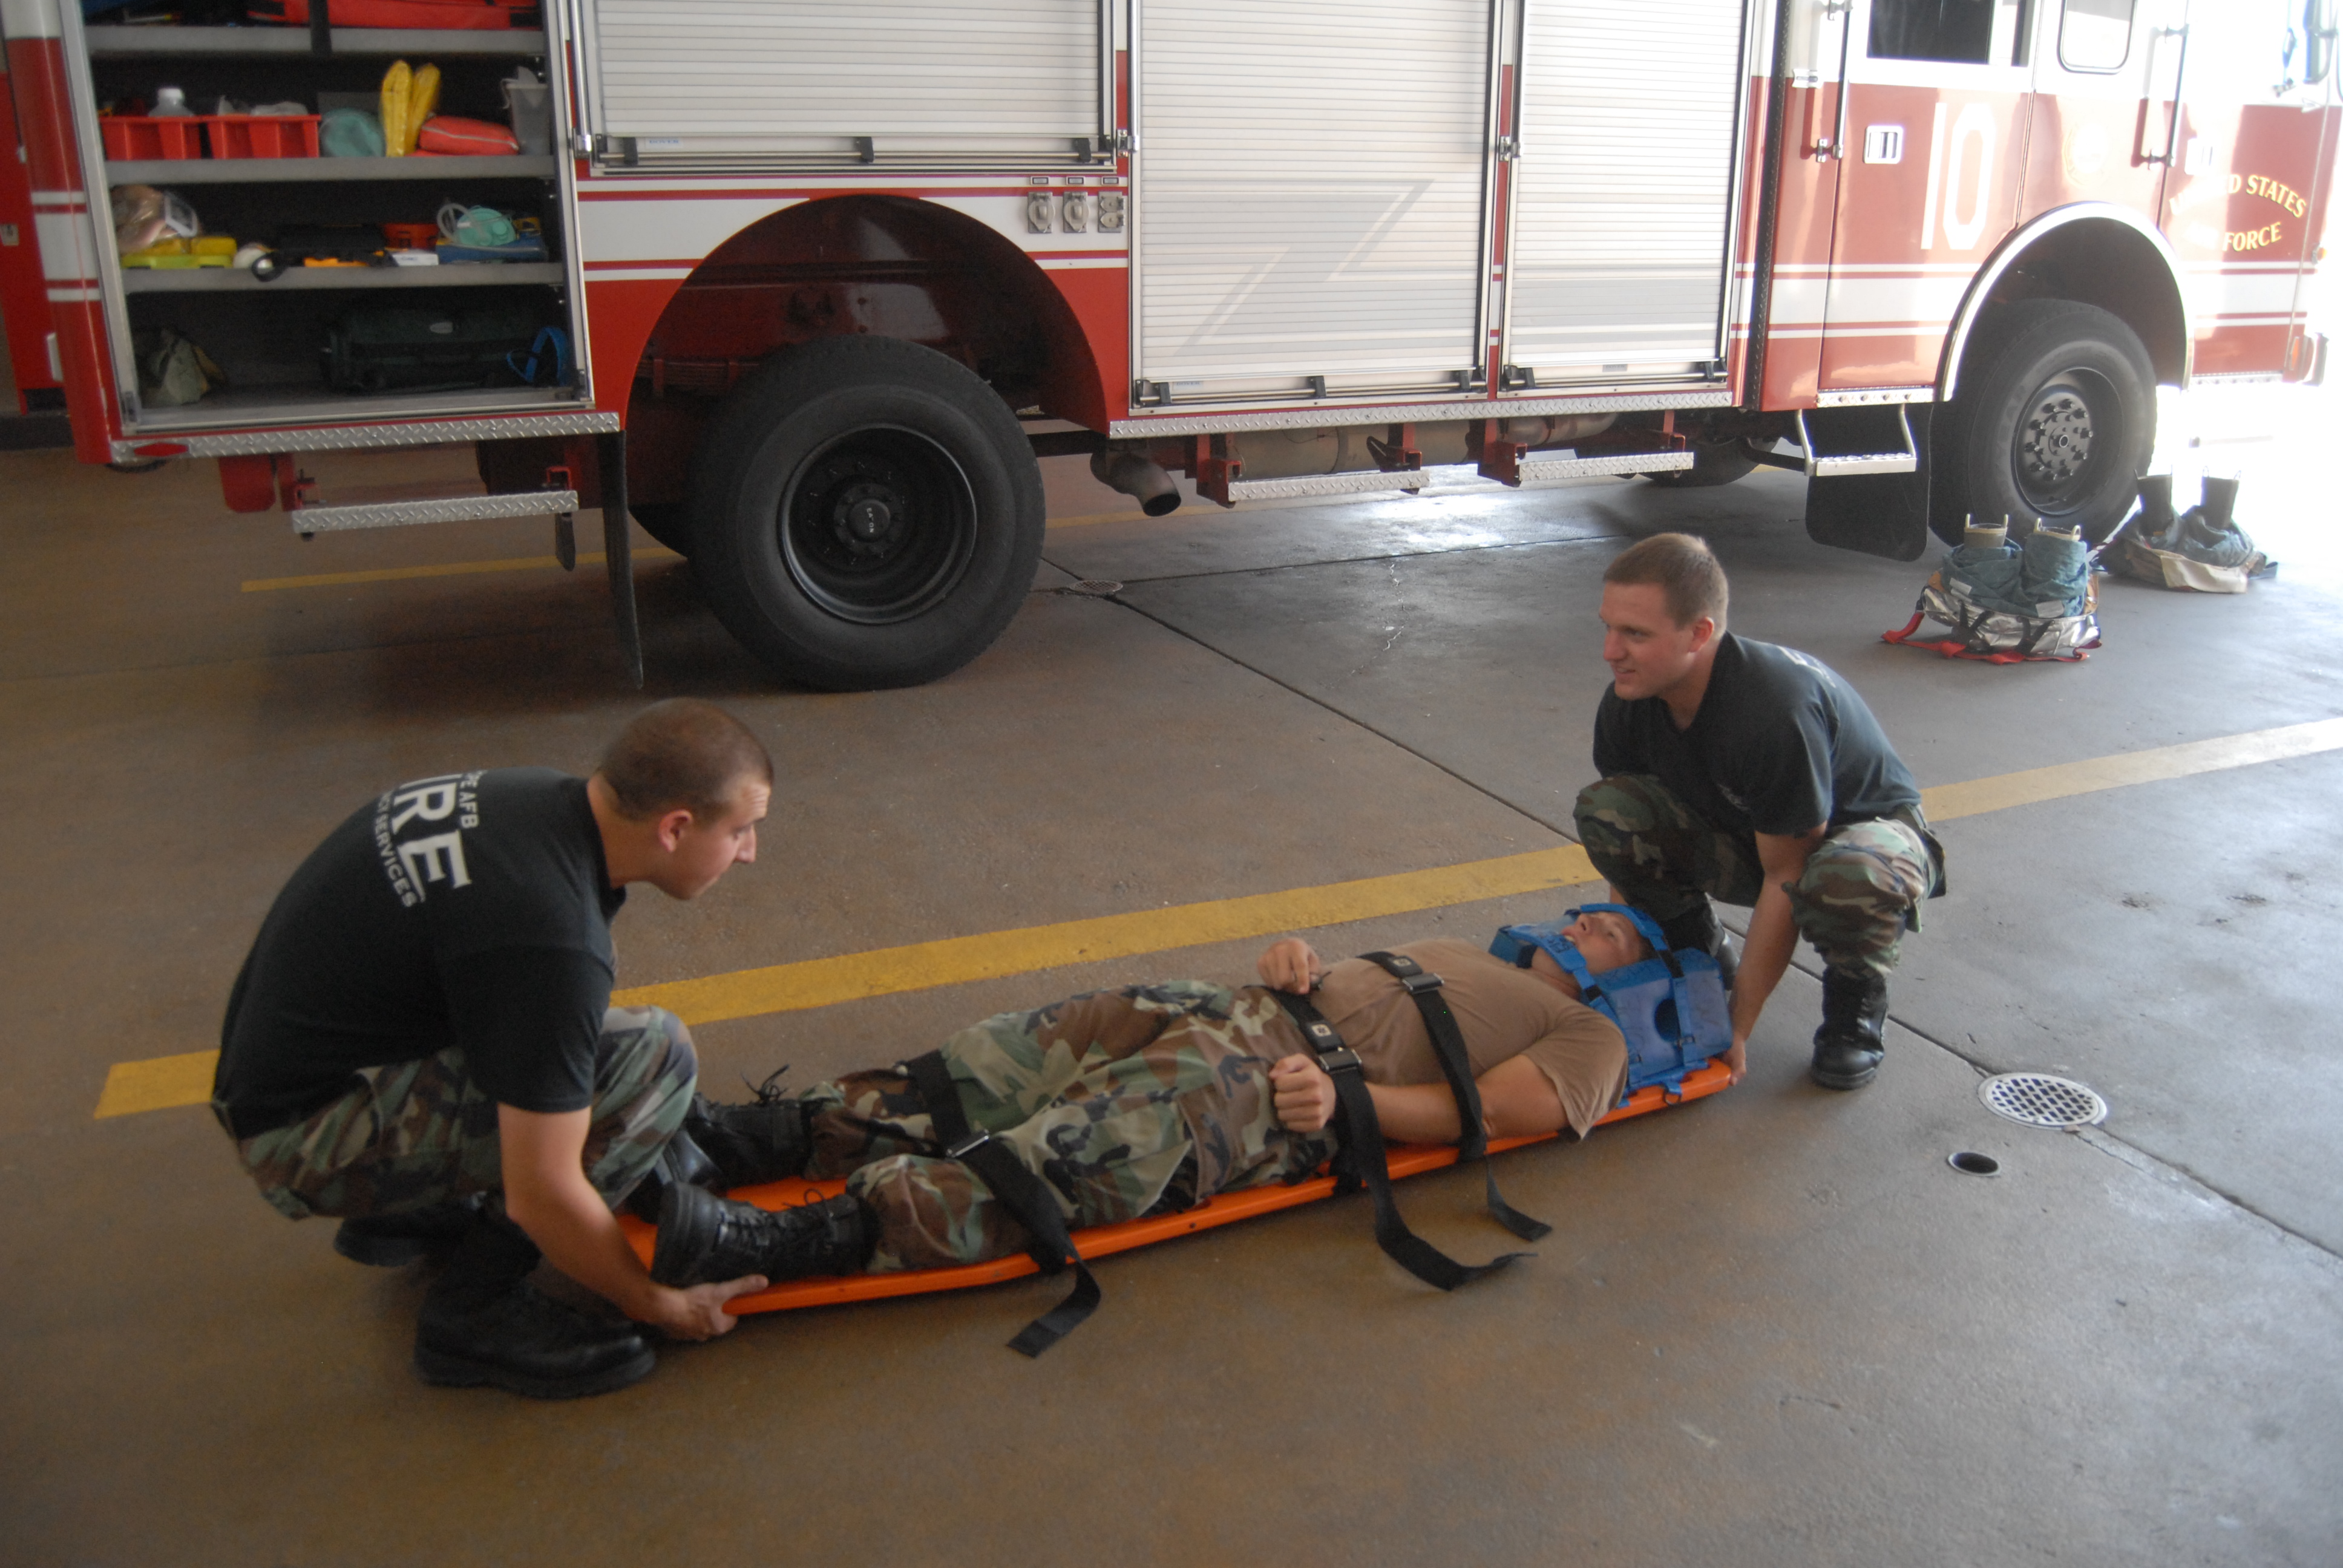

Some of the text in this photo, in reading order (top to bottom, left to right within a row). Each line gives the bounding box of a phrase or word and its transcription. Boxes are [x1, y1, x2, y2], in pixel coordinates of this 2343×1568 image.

[1921, 102, 1997, 250] 10
[2246, 174, 2307, 218] STATES
[2222, 221, 2282, 252] FORCE
[459, 791, 480, 829] AFB
[375, 814, 418, 907] SERVICES
